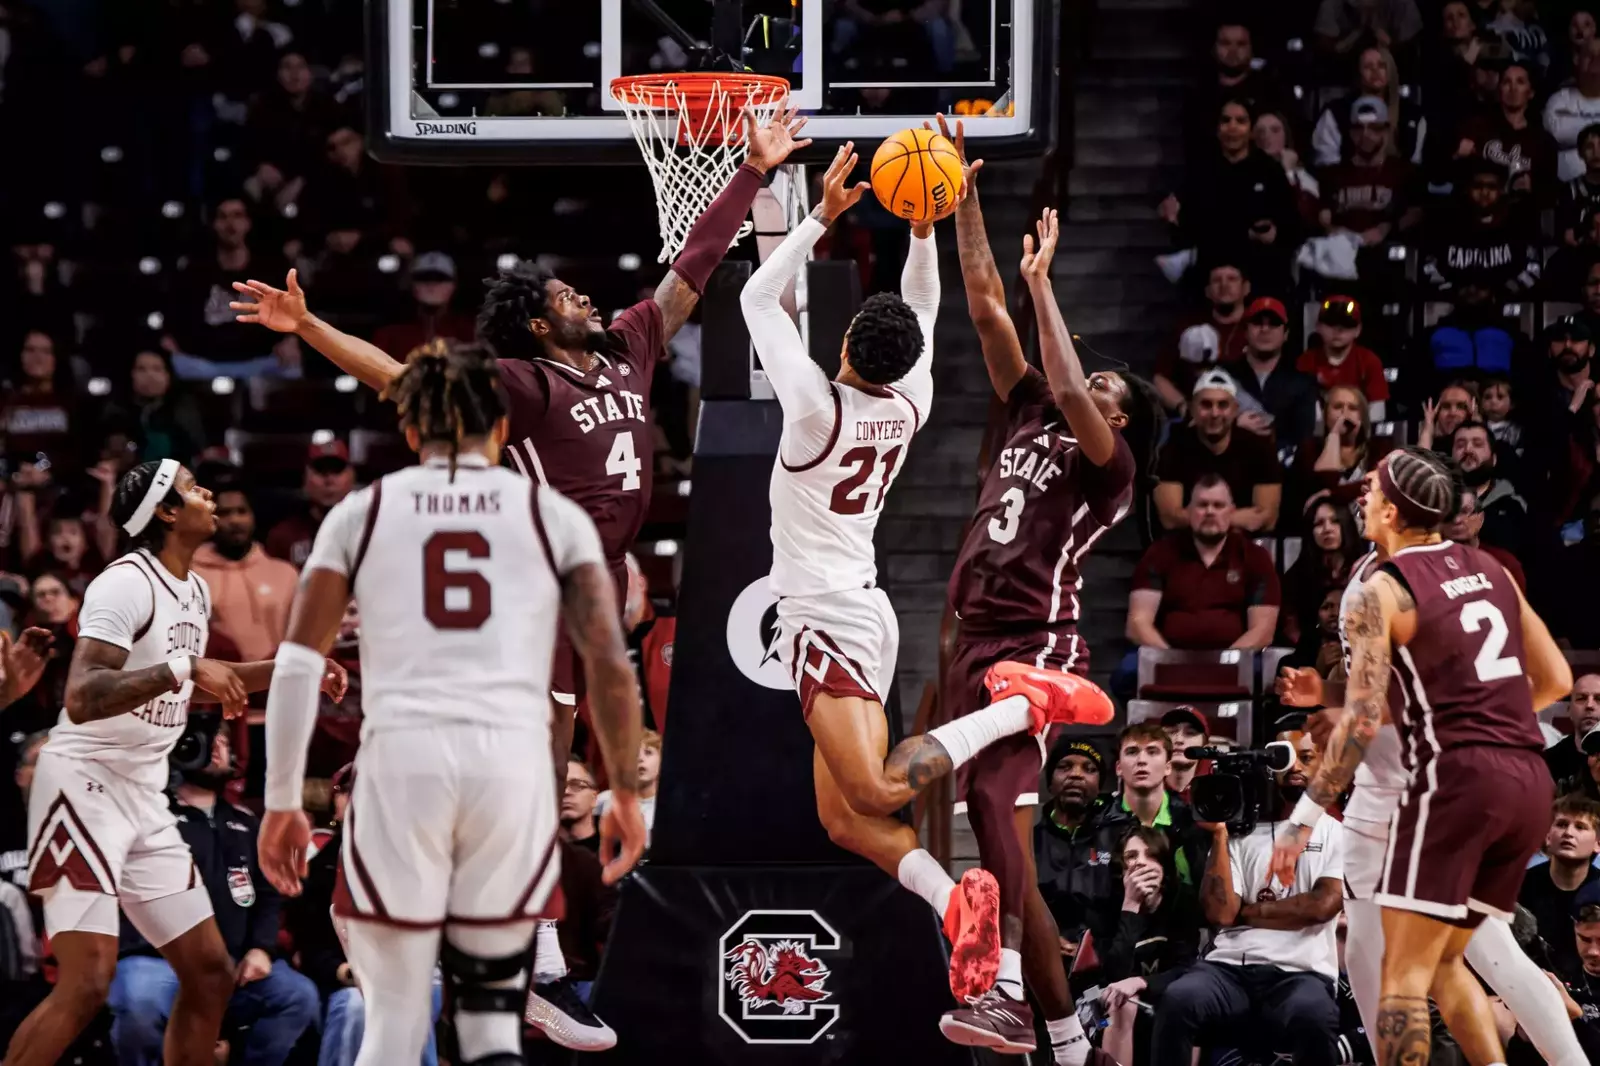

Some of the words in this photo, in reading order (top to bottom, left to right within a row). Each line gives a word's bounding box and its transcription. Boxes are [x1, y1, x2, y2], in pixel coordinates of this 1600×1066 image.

[415, 121, 477, 136] SPALDING
[569, 390, 646, 434] STATE
[856, 420, 906, 441] CONYERS
[605, 431, 642, 491] 4
[828, 443, 904, 515] 21
[999, 447, 1062, 492] STATE
[411, 490, 501, 515] THOMAS
[988, 486, 1026, 545] 3
[422, 529, 492, 631] 6
[1459, 599, 1523, 682] 2
